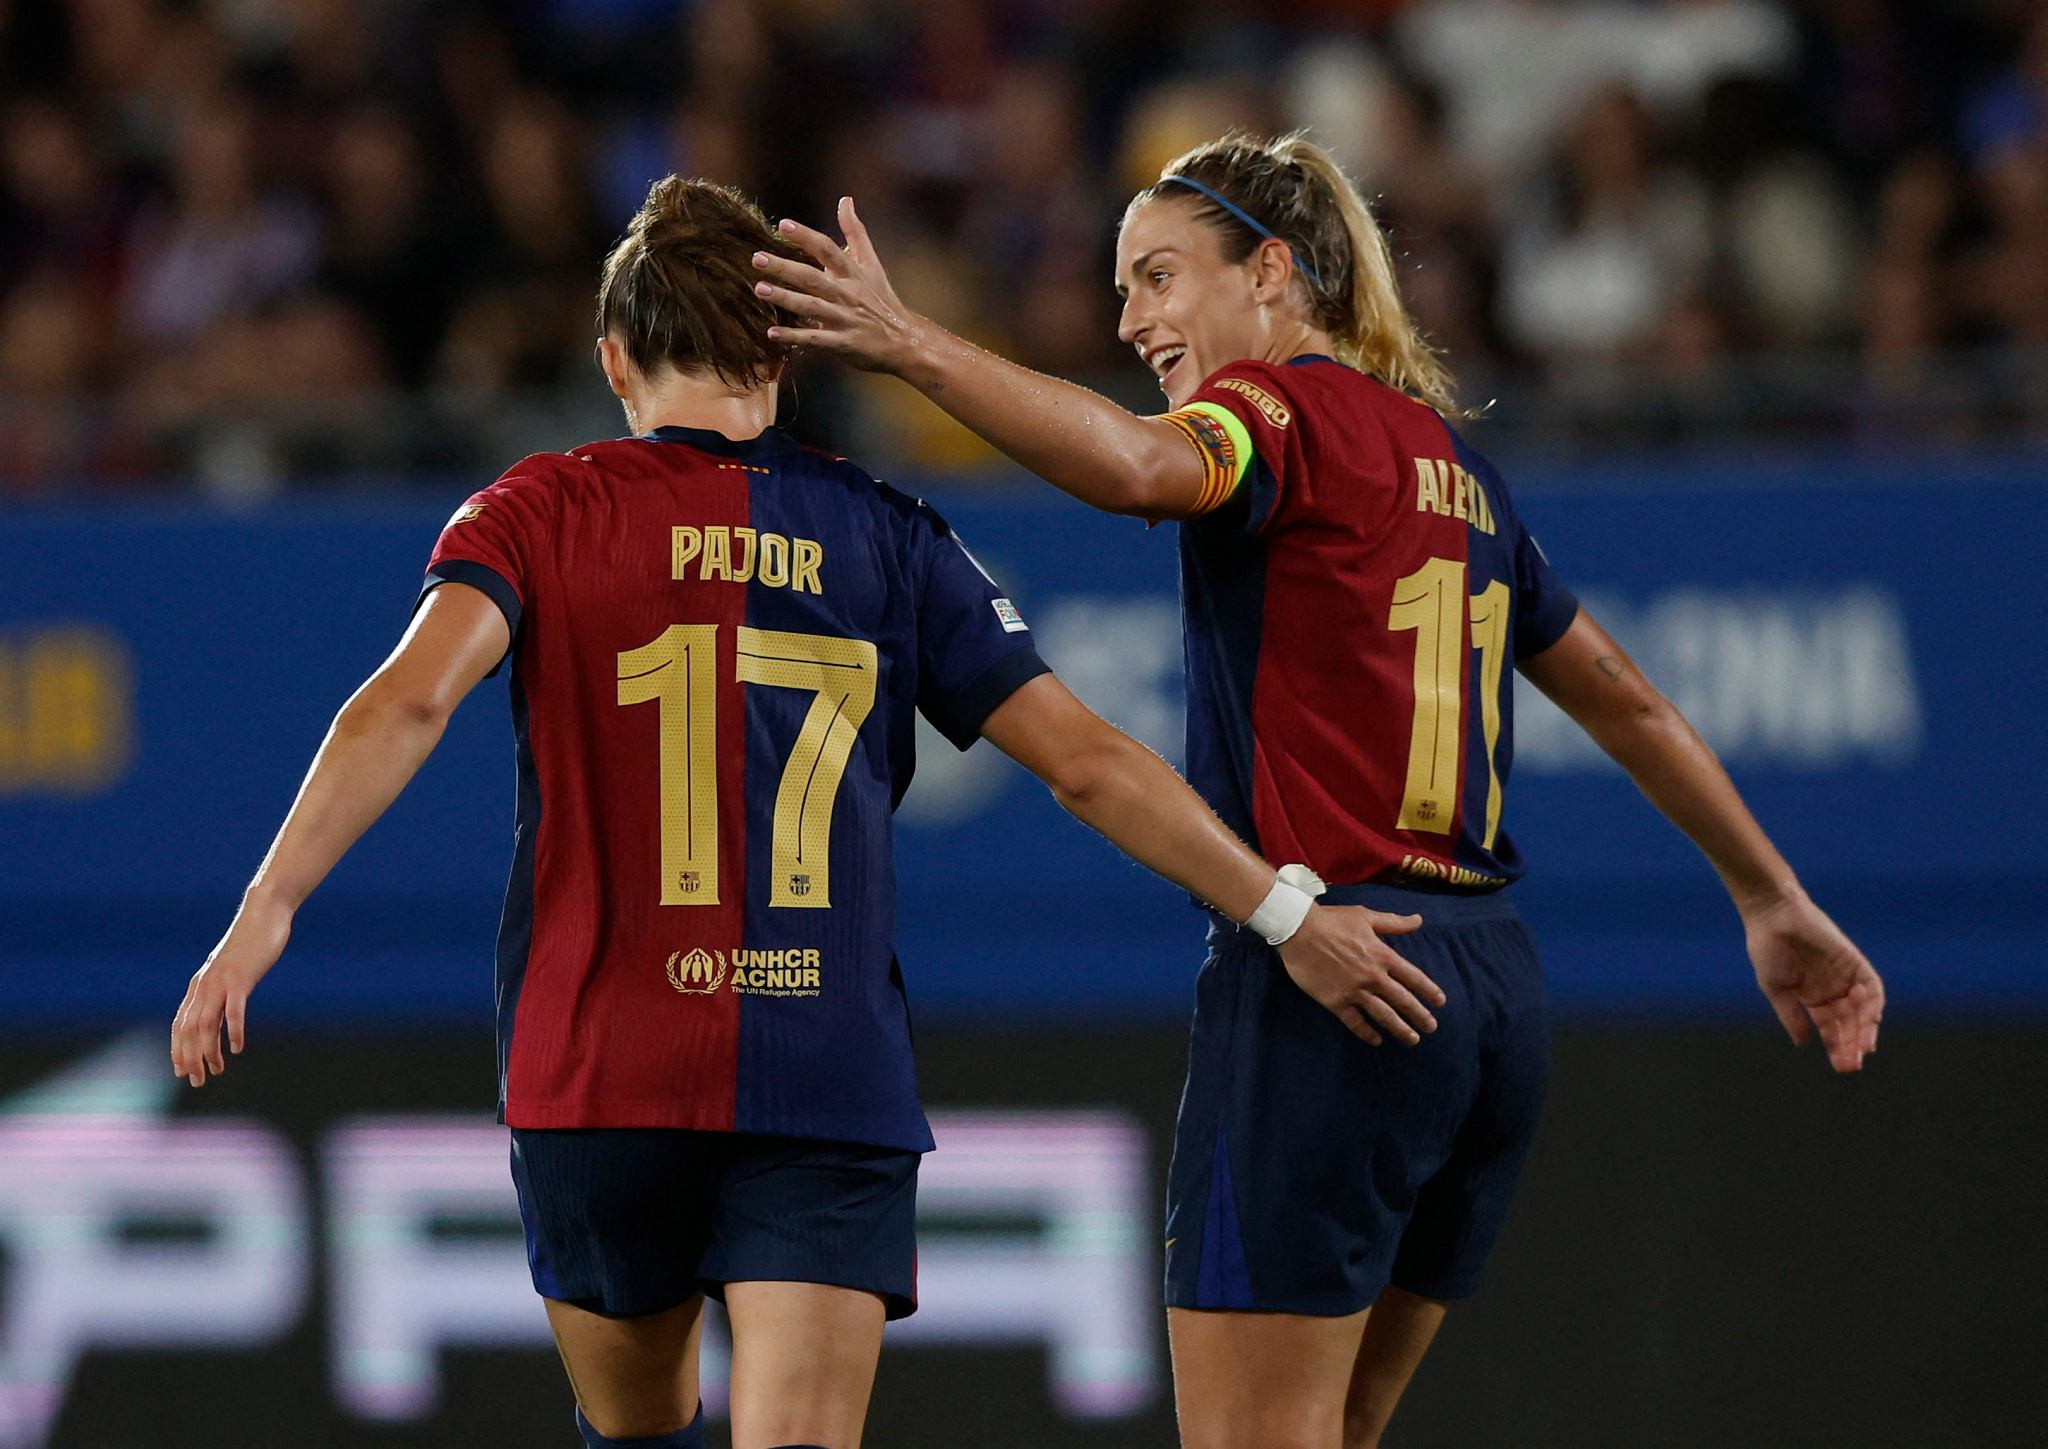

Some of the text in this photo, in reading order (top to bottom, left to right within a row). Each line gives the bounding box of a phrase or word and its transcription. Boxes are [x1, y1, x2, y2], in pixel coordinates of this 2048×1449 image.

[1215, 380, 1291, 427] BIMBO
[671, 525, 823, 596] PAJOR
[1387, 556, 1511, 852] 11
[617, 624, 878, 909] 17
[1449, 865, 1507, 885] UNH
[731, 948, 820, 969] UNHCR
[730, 968, 820, 988] ACNUR
[731, 986, 820, 998] The UN Refugee Agency
